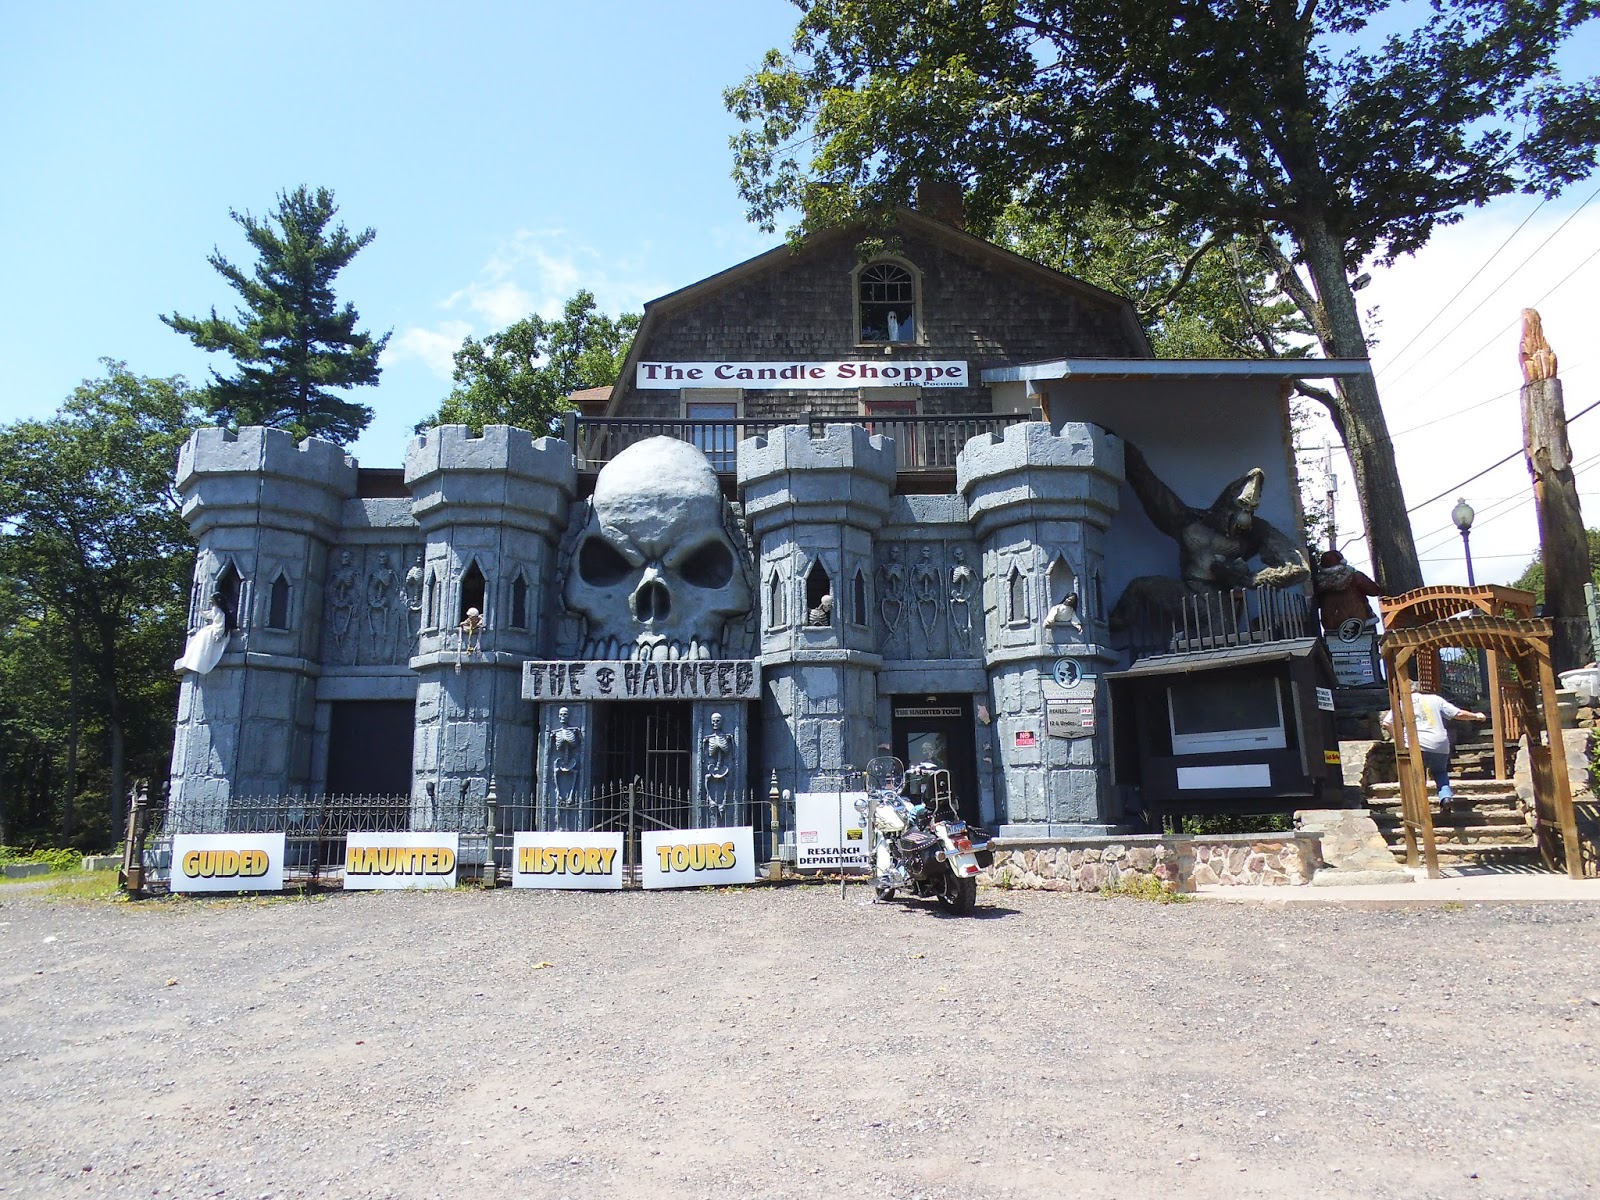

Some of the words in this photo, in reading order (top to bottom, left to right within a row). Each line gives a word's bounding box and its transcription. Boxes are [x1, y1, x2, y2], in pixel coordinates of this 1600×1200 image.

[642, 364, 702, 380] The
[714, 364, 826, 380] Candle
[836, 363, 962, 381] Shoppe
[530, 663, 586, 697] THE
[624, 662, 753, 698] HAUNTED
[182, 850, 270, 878] GUIDED
[347, 846, 456, 875] HAUNTED
[518, 846, 617, 875] HISTORY
[656, 842, 736, 872] TOURS
[799, 855, 868, 864] DEPARTMENT
[808, 847, 860, 855] RESEARCH
